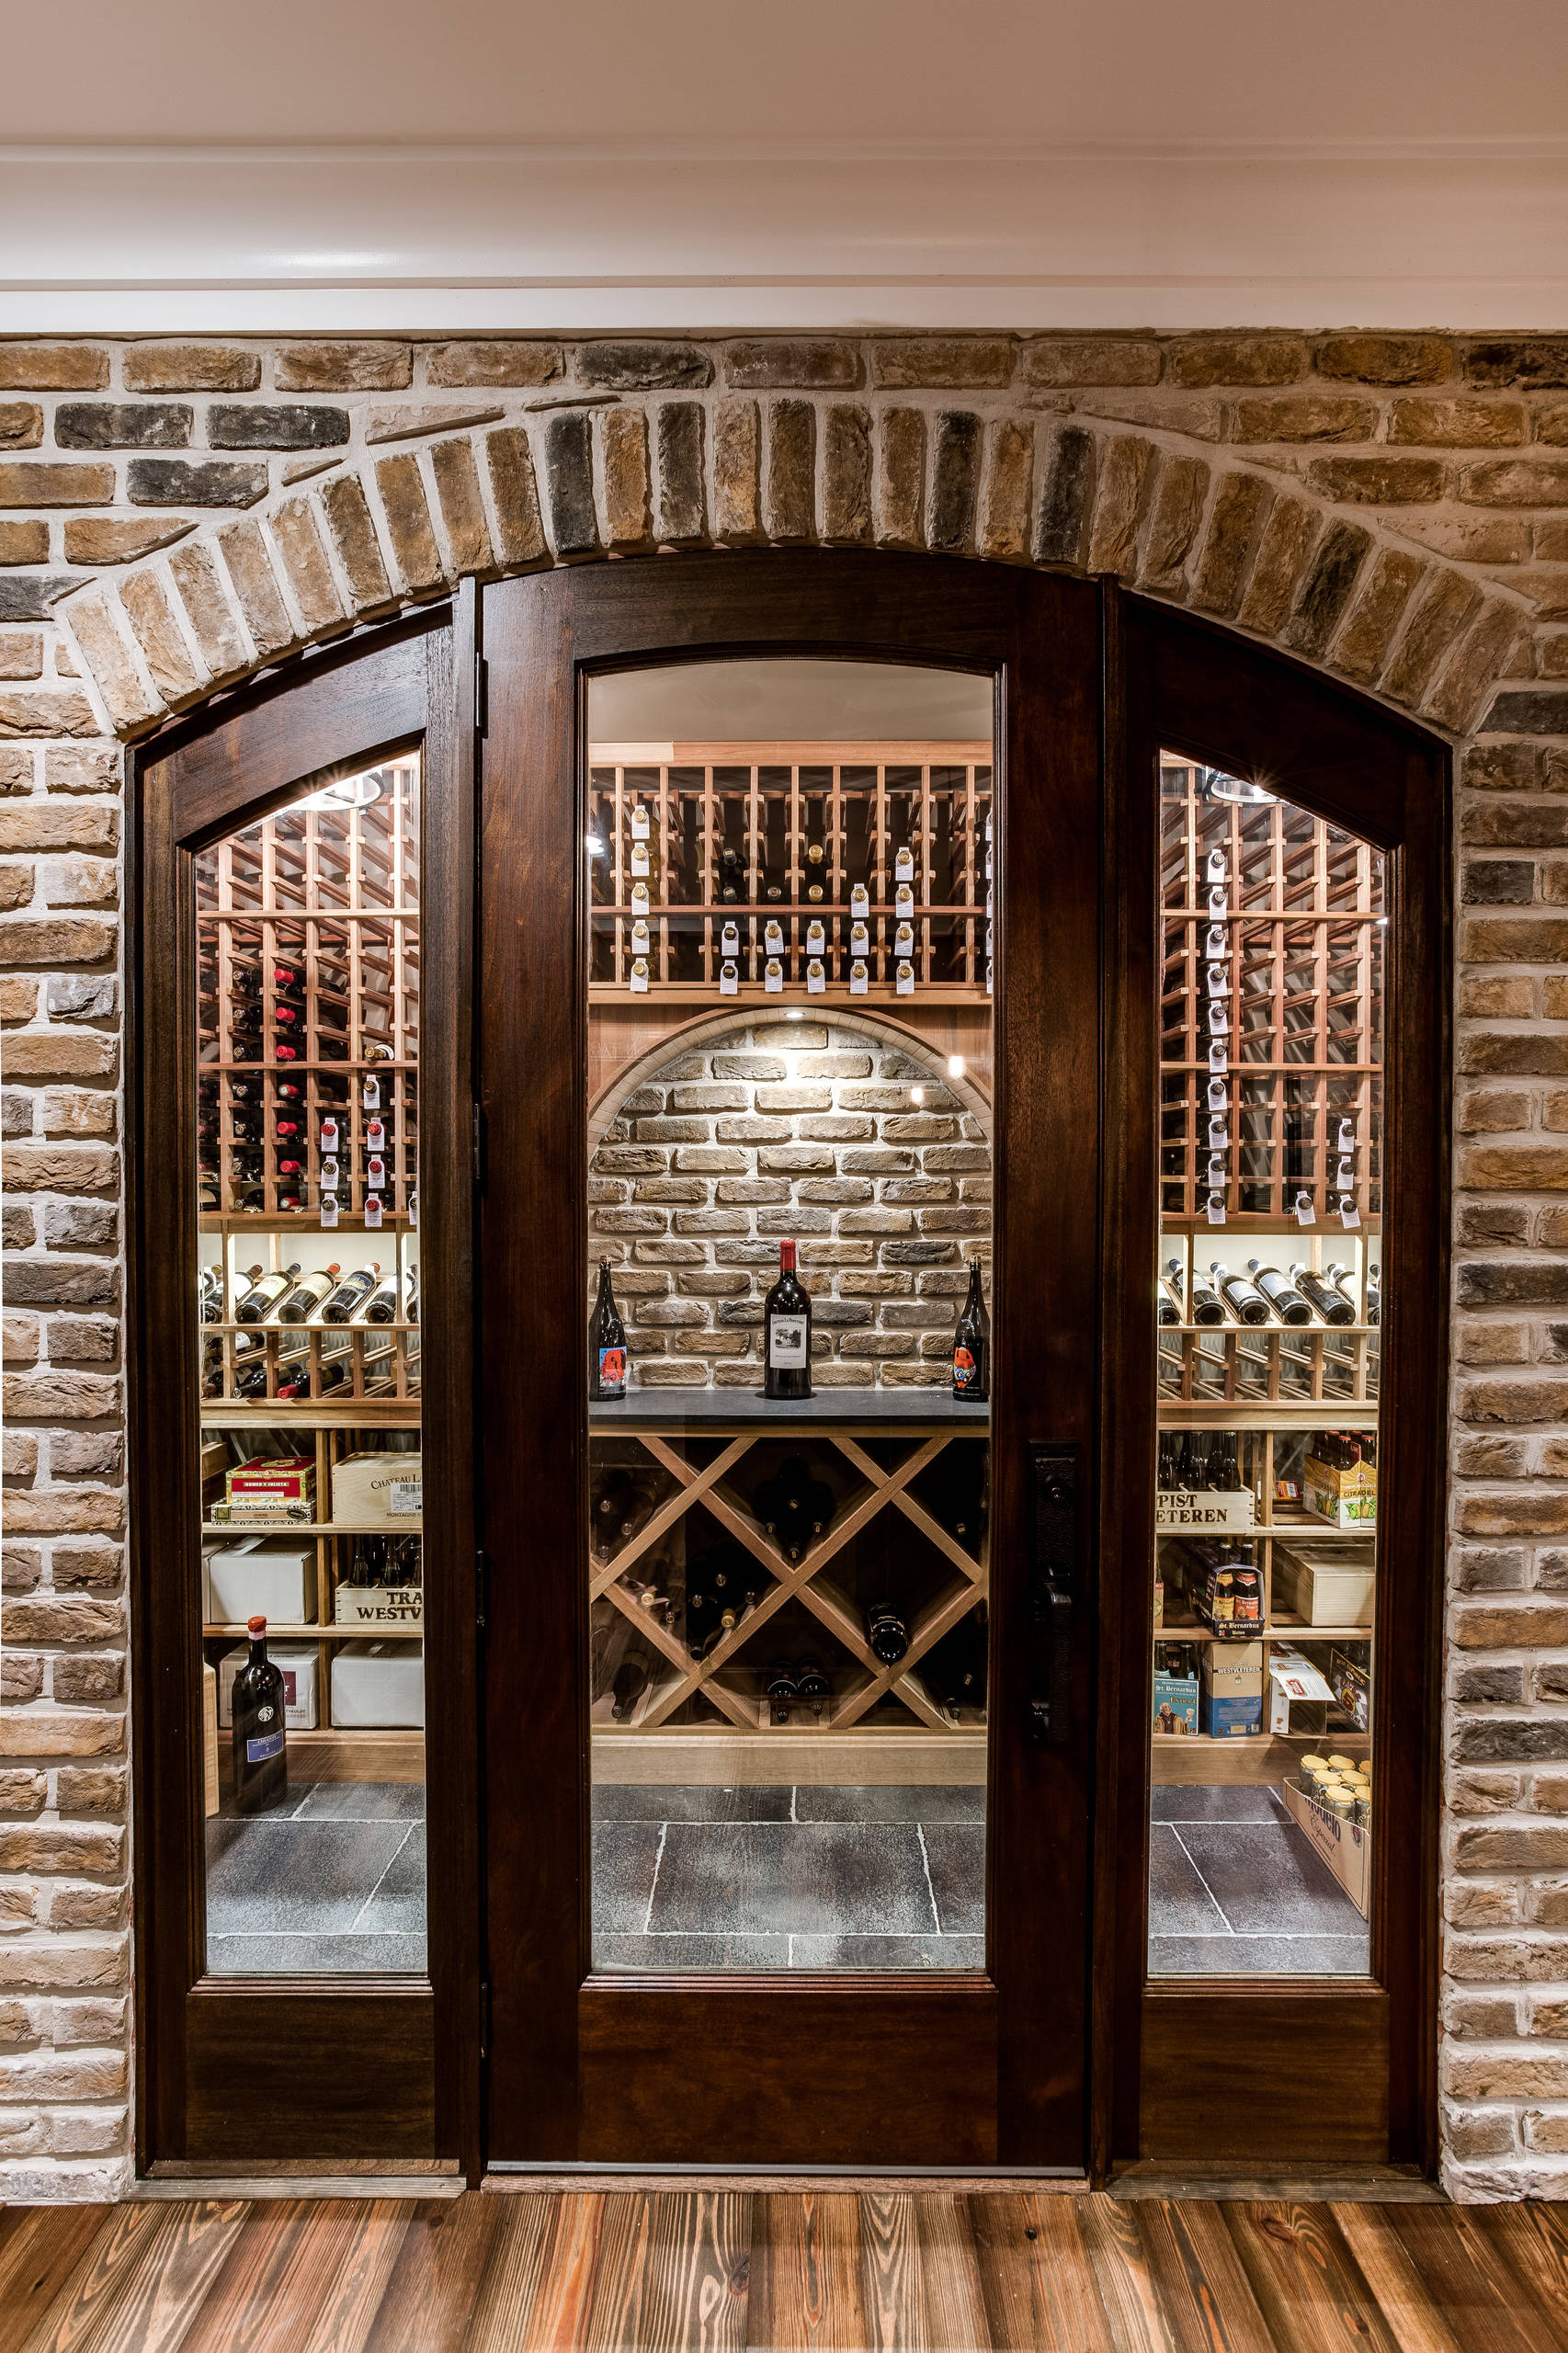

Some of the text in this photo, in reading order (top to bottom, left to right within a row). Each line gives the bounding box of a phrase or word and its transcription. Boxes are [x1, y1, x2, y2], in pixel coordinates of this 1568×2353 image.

[370, 1475, 411, 1490] CHATEAU
[1156, 1508, 1228, 1523] ETEREN
[387, 1591, 422, 1605] TRA
[356, 1607, 422, 1620] WESTV
